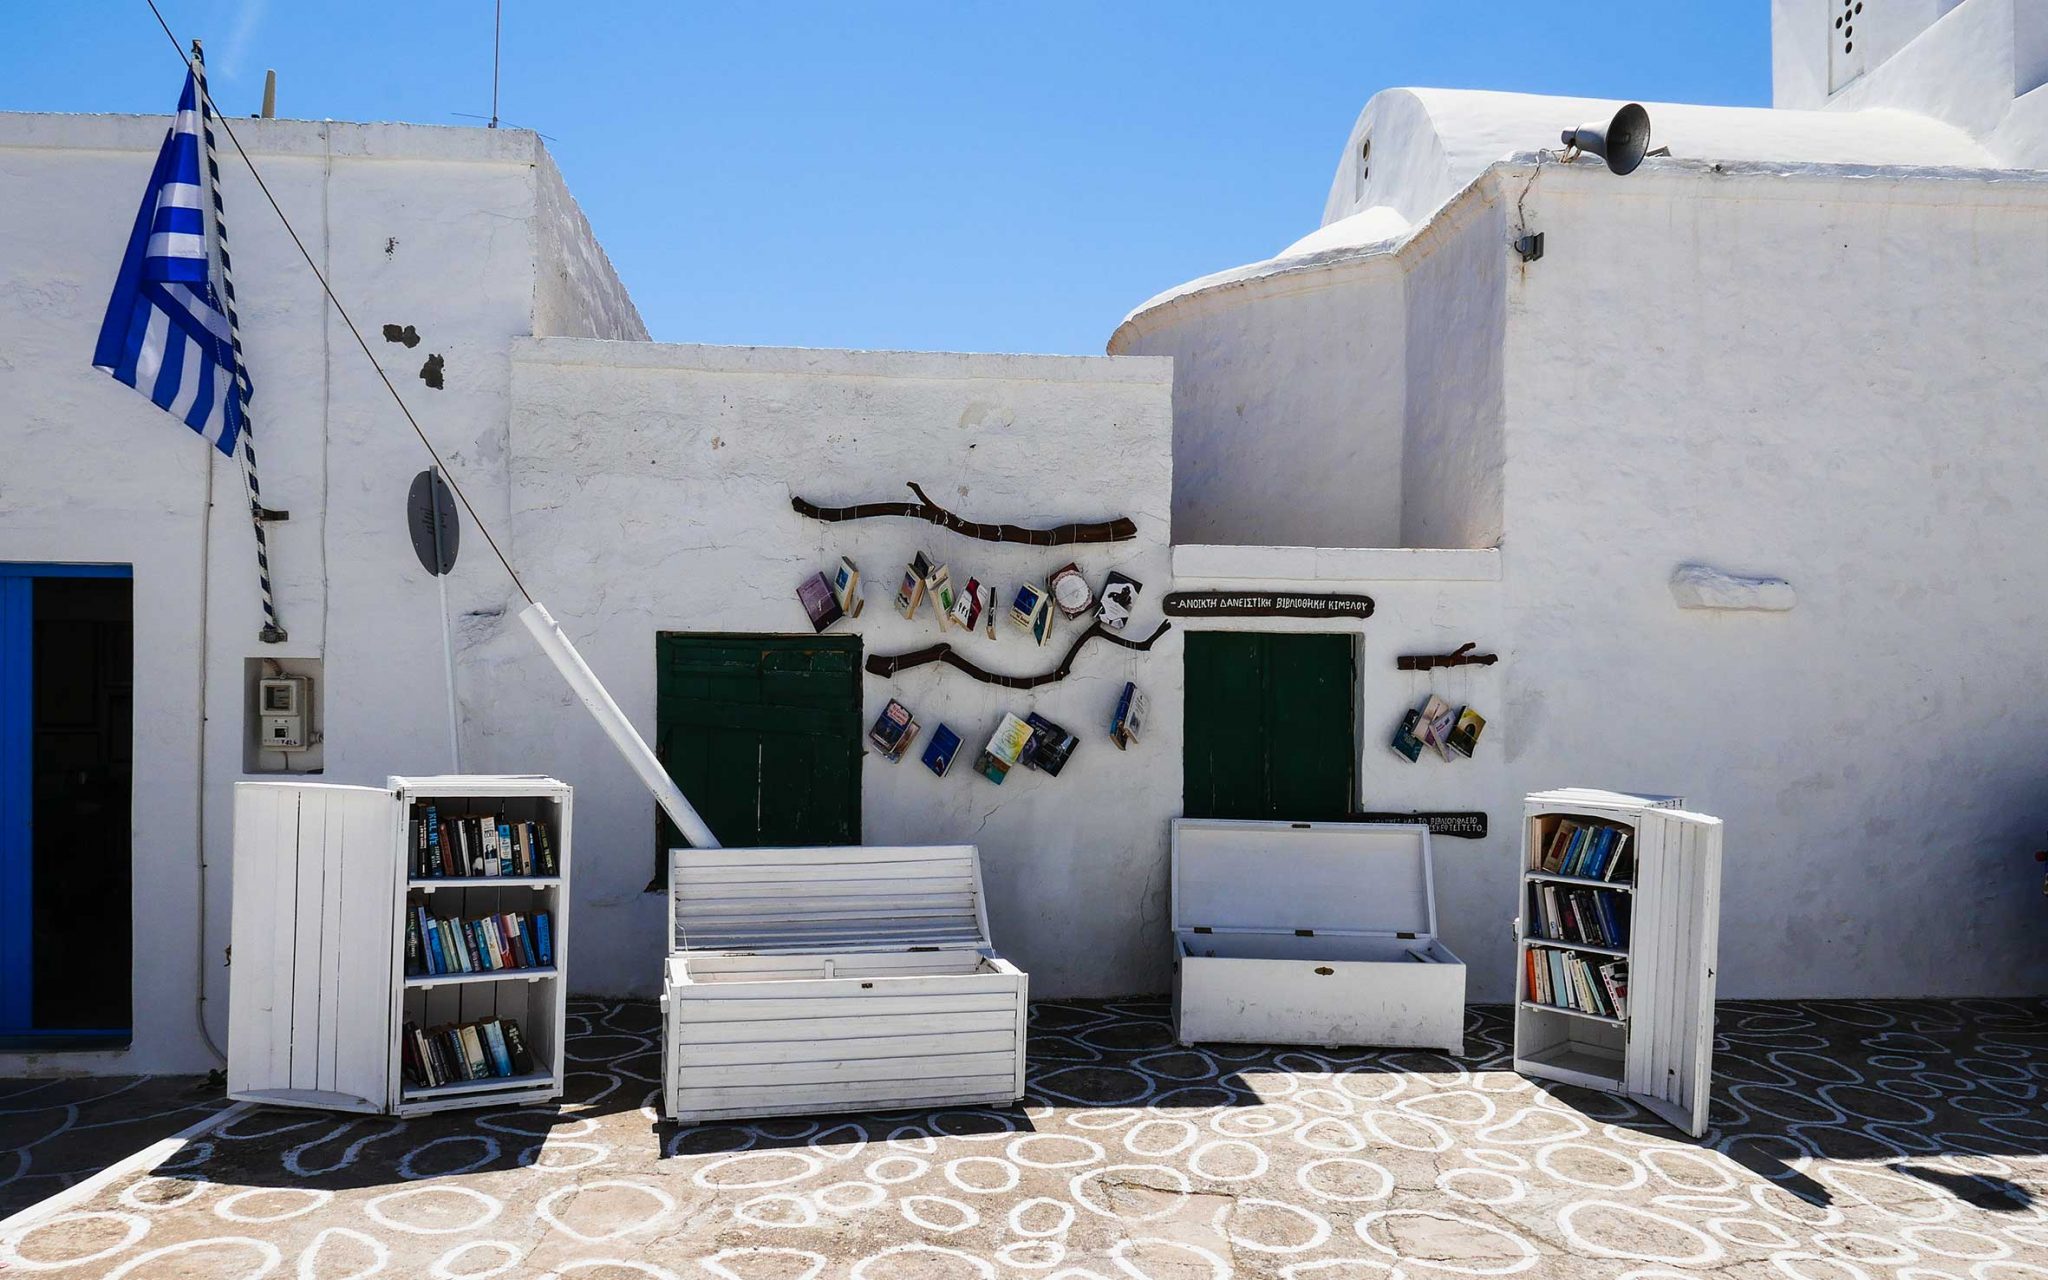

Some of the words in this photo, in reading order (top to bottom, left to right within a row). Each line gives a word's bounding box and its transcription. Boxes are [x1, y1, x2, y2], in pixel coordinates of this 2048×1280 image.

[1177, 598, 1218, 609] ΑΝΟΙΚΤΗ
[1219, 597, 1272, 608] ΔΑΝΕΙΣΤΙΚΗ
[1275, 597, 1326, 609] ΒΙΒΛΙΟΘΗΚΗ
